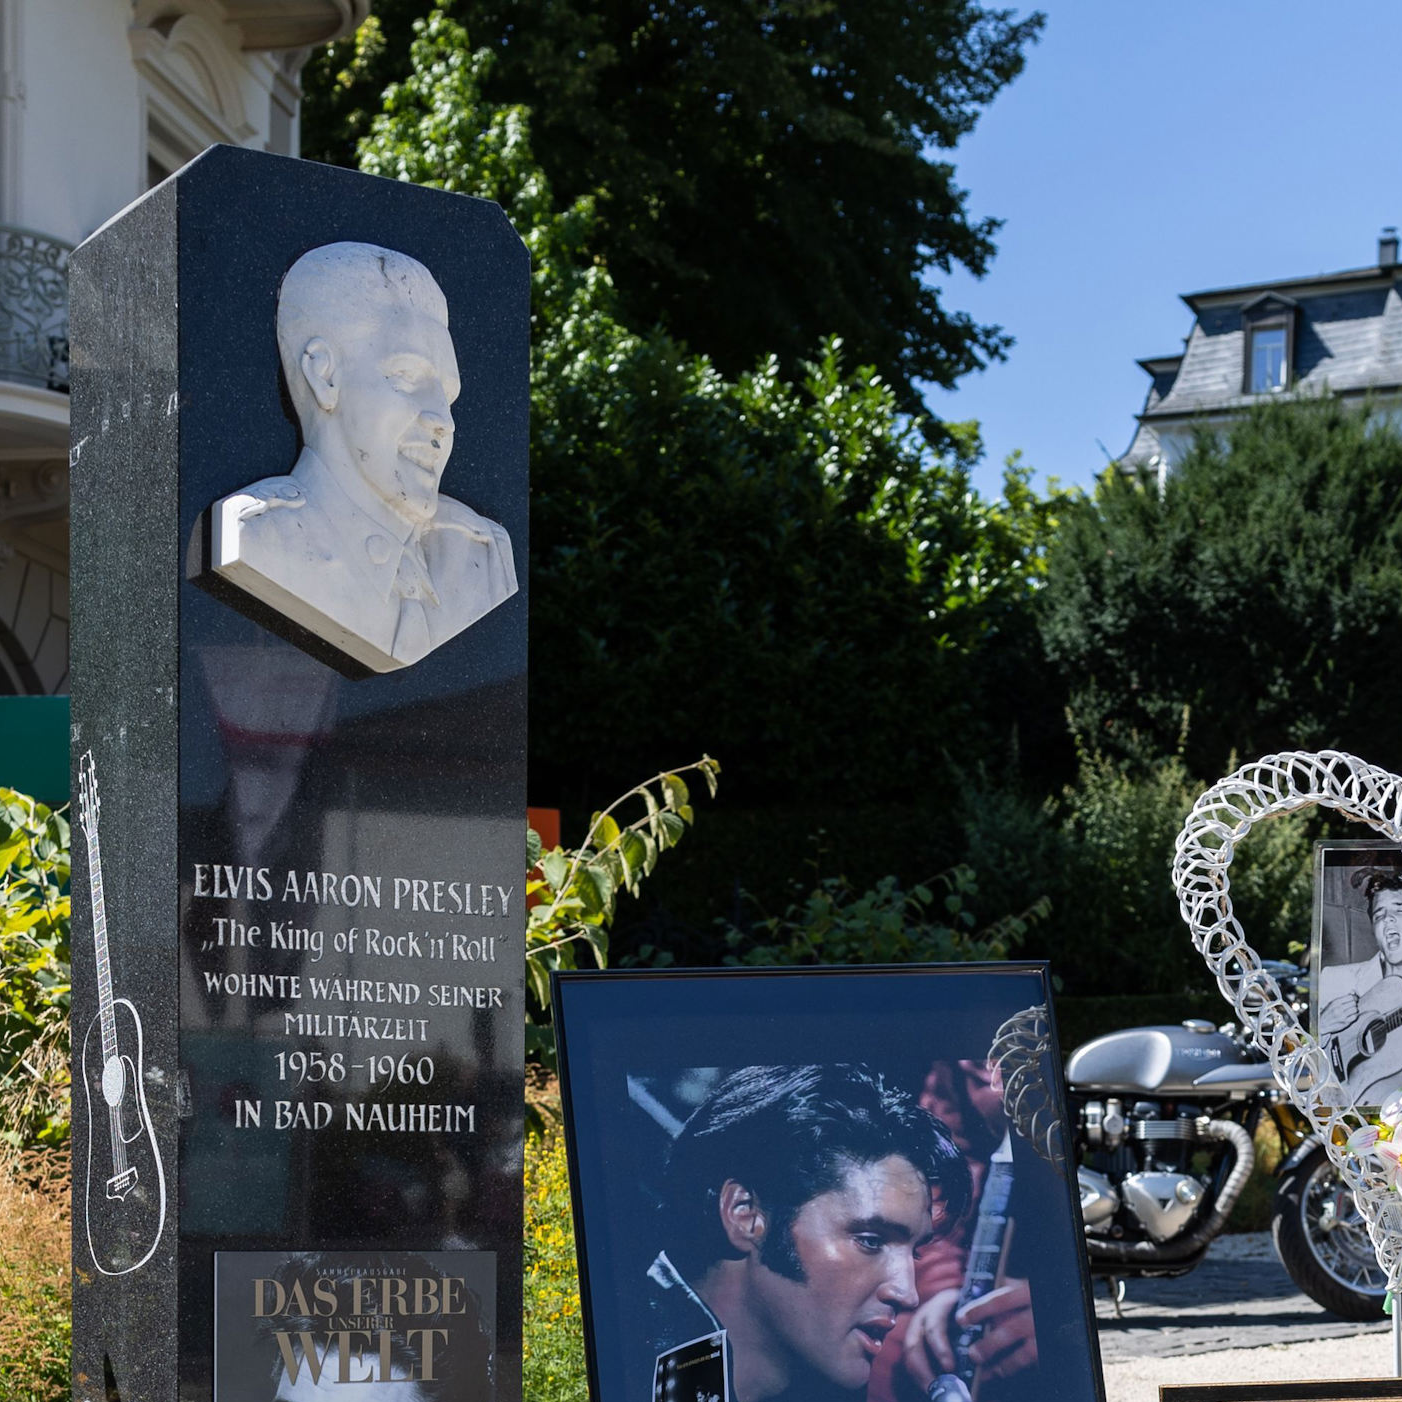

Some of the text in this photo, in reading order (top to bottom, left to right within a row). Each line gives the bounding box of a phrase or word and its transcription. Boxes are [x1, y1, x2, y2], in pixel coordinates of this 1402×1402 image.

[194, 864, 514, 918] ELVIS AARON PRESLEY
[270, 920, 325, 963] King
[333, 927, 361, 954] of
[203, 971, 503, 1009] WOHNTE WÄHREND SEINER
[284, 1009, 429, 1042] MILITÄRZEIT
[235, 1100, 476, 1133] IN BAD NAUHEIM
[251, 1277, 467, 1317] DAS ERBE
[328, 1316, 394, 1330] UNSERER
[271, 1329, 448, 1386] WELT
